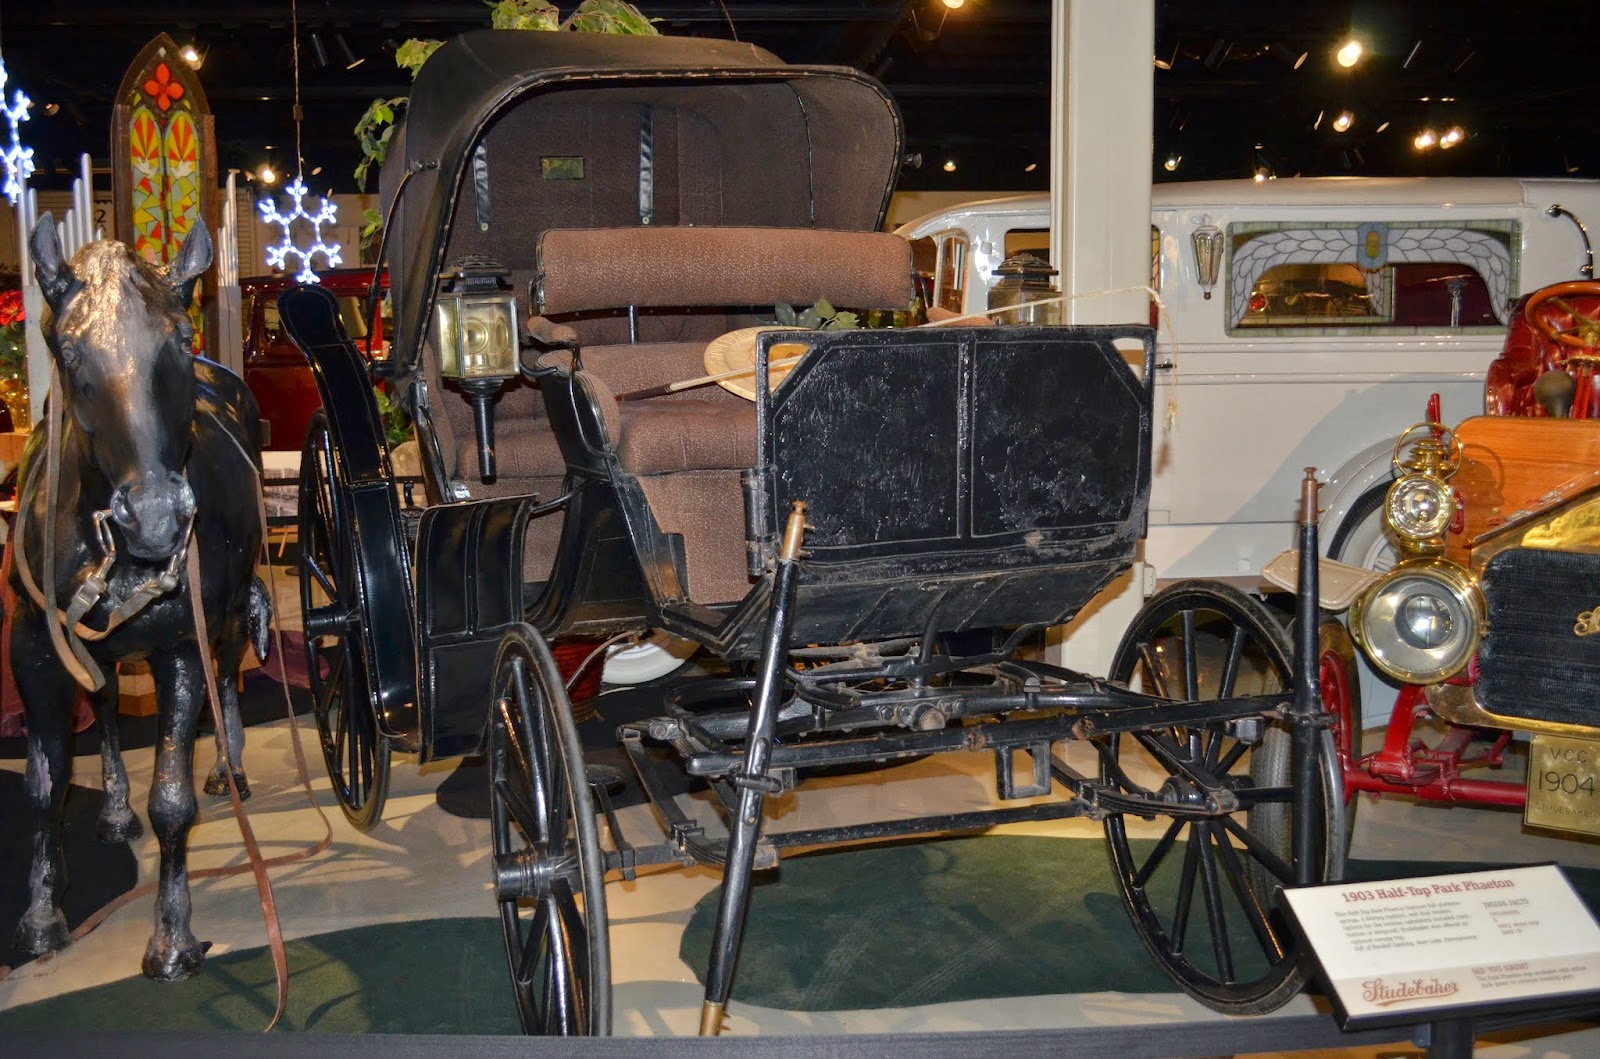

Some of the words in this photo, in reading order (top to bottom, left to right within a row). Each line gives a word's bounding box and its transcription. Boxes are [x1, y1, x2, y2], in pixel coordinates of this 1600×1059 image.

[1550, 747, 1587, 763] VCC
[1539, 770, 1596, 797] 1904
[1535, 803, 1596, 818] STUDEBAKER
[1341, 890, 1375, 902] 1903
[1375, 886, 1431, 897] Half-Top
[1431, 882, 1462, 894] Park
[1461, 879, 1515, 891] Phaeton
[1362, 978, 1459, 1005] Studebaker
